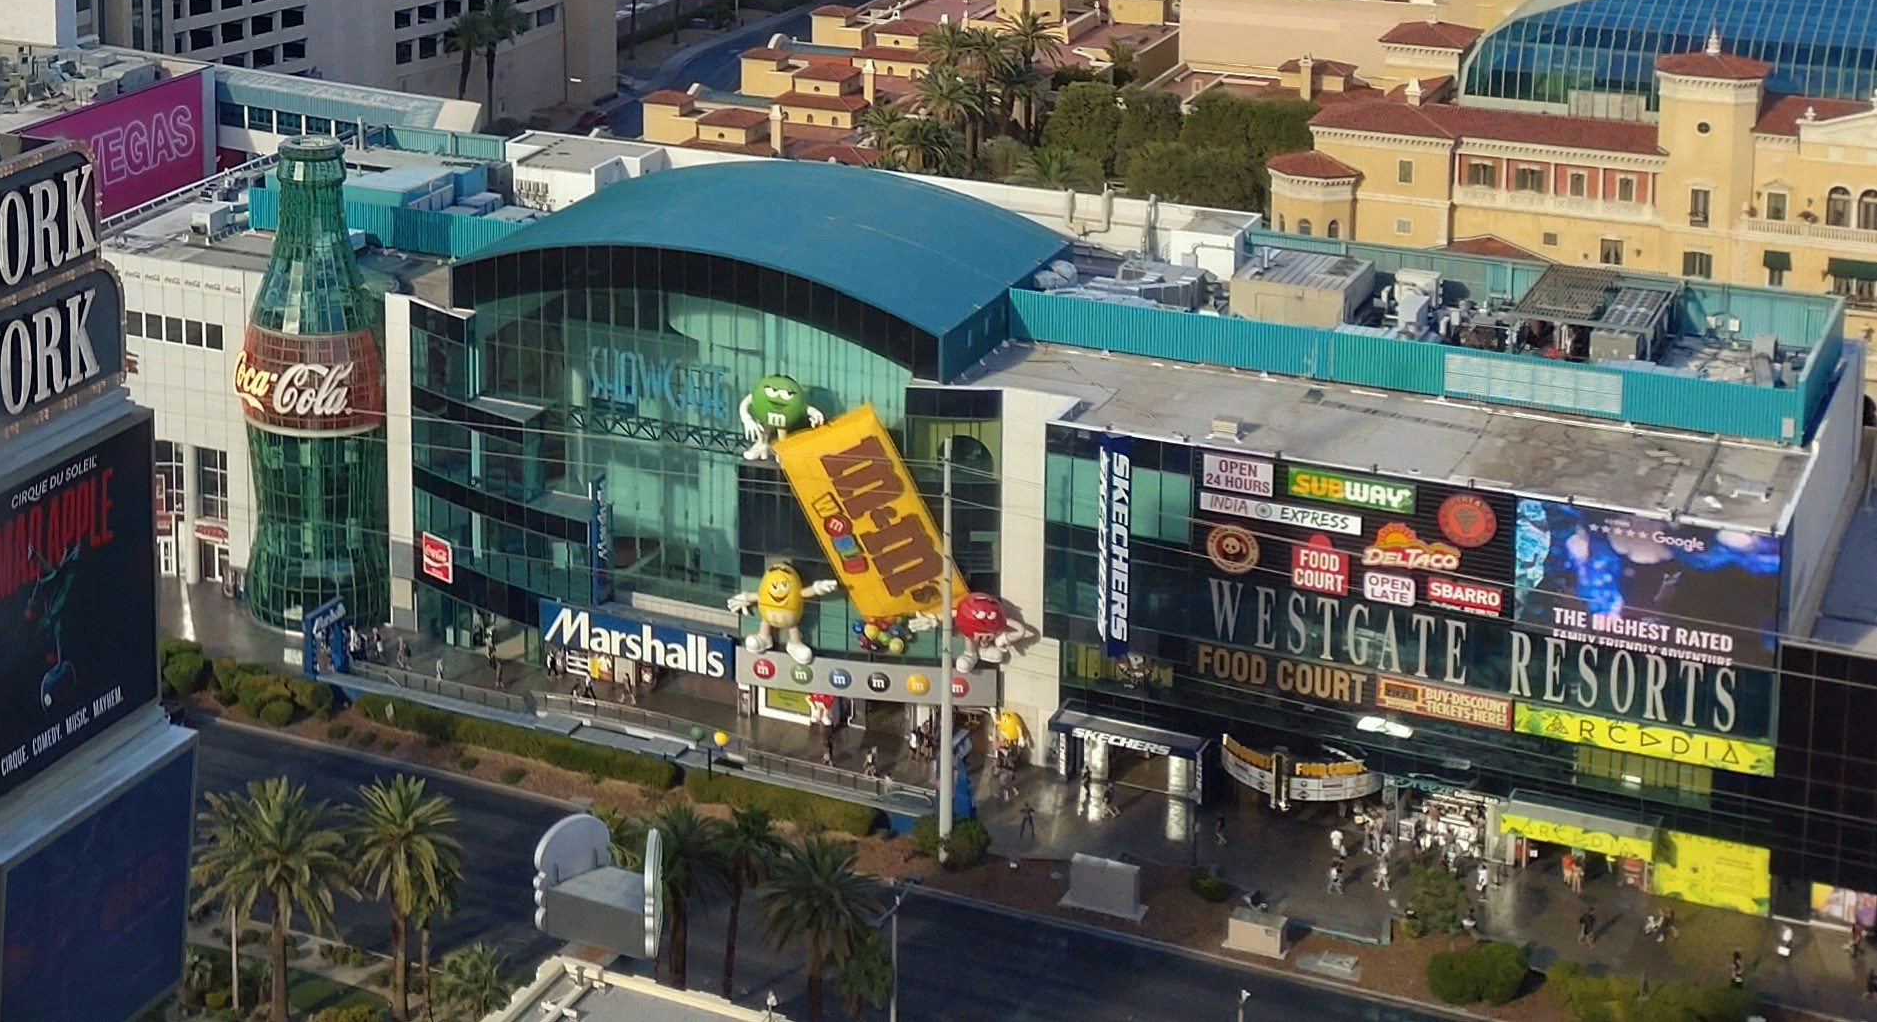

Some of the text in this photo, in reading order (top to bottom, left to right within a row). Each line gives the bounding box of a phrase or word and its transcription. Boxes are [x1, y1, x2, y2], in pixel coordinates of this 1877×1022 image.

[233, 350, 355, 416] Coca-Cola
[767, 411, 786, 428] m
[11, 454, 98, 509] CIRQUE DU SOLEIL
[1205, 472, 1271, 495] 24 HOURS
[1218, 459, 1258, 478] OPEN
[1293, 472, 1412, 509] SUBWAY
[47, 466, 114, 569] APPLE
[1209, 494, 1350, 530] INDIA EXPRESS
[1110, 451, 1131, 643] SKECHERS
[1652, 530, 1705, 553] Google
[1299, 549, 1340, 572] FOOD
[1364, 547, 1459, 570] DEL TACO
[1293, 567, 1345, 593] COURT
[1368, 574, 1412, 592] OPEN
[1430, 581, 1501, 607] SBARRO
[1370, 588, 1409, 604] LATE
[544, 607, 725, 678] Marshalls
[1553, 607, 1734, 653] THE HIGHEST RATED
[1208, 578, 1737, 733] WESTGATE RESORTS
[755, 661, 965, 694] m m m m m m
[1196, 643, 1268, 686] FOOD
[1276, 660, 1368, 704] COURT
[1424, 688, 1450, 704] BUY
[1450, 691, 1508, 714] DISCOUNT
[1425, 700, 1472, 721] TICKETS
[1, 685, 124, 777] CIRQUE. COMEDY. MUSIC. MAYHEM.
[1072, 727, 1171, 756] SKECHERS
[1545, 715, 1740, 764] ARCADIA
